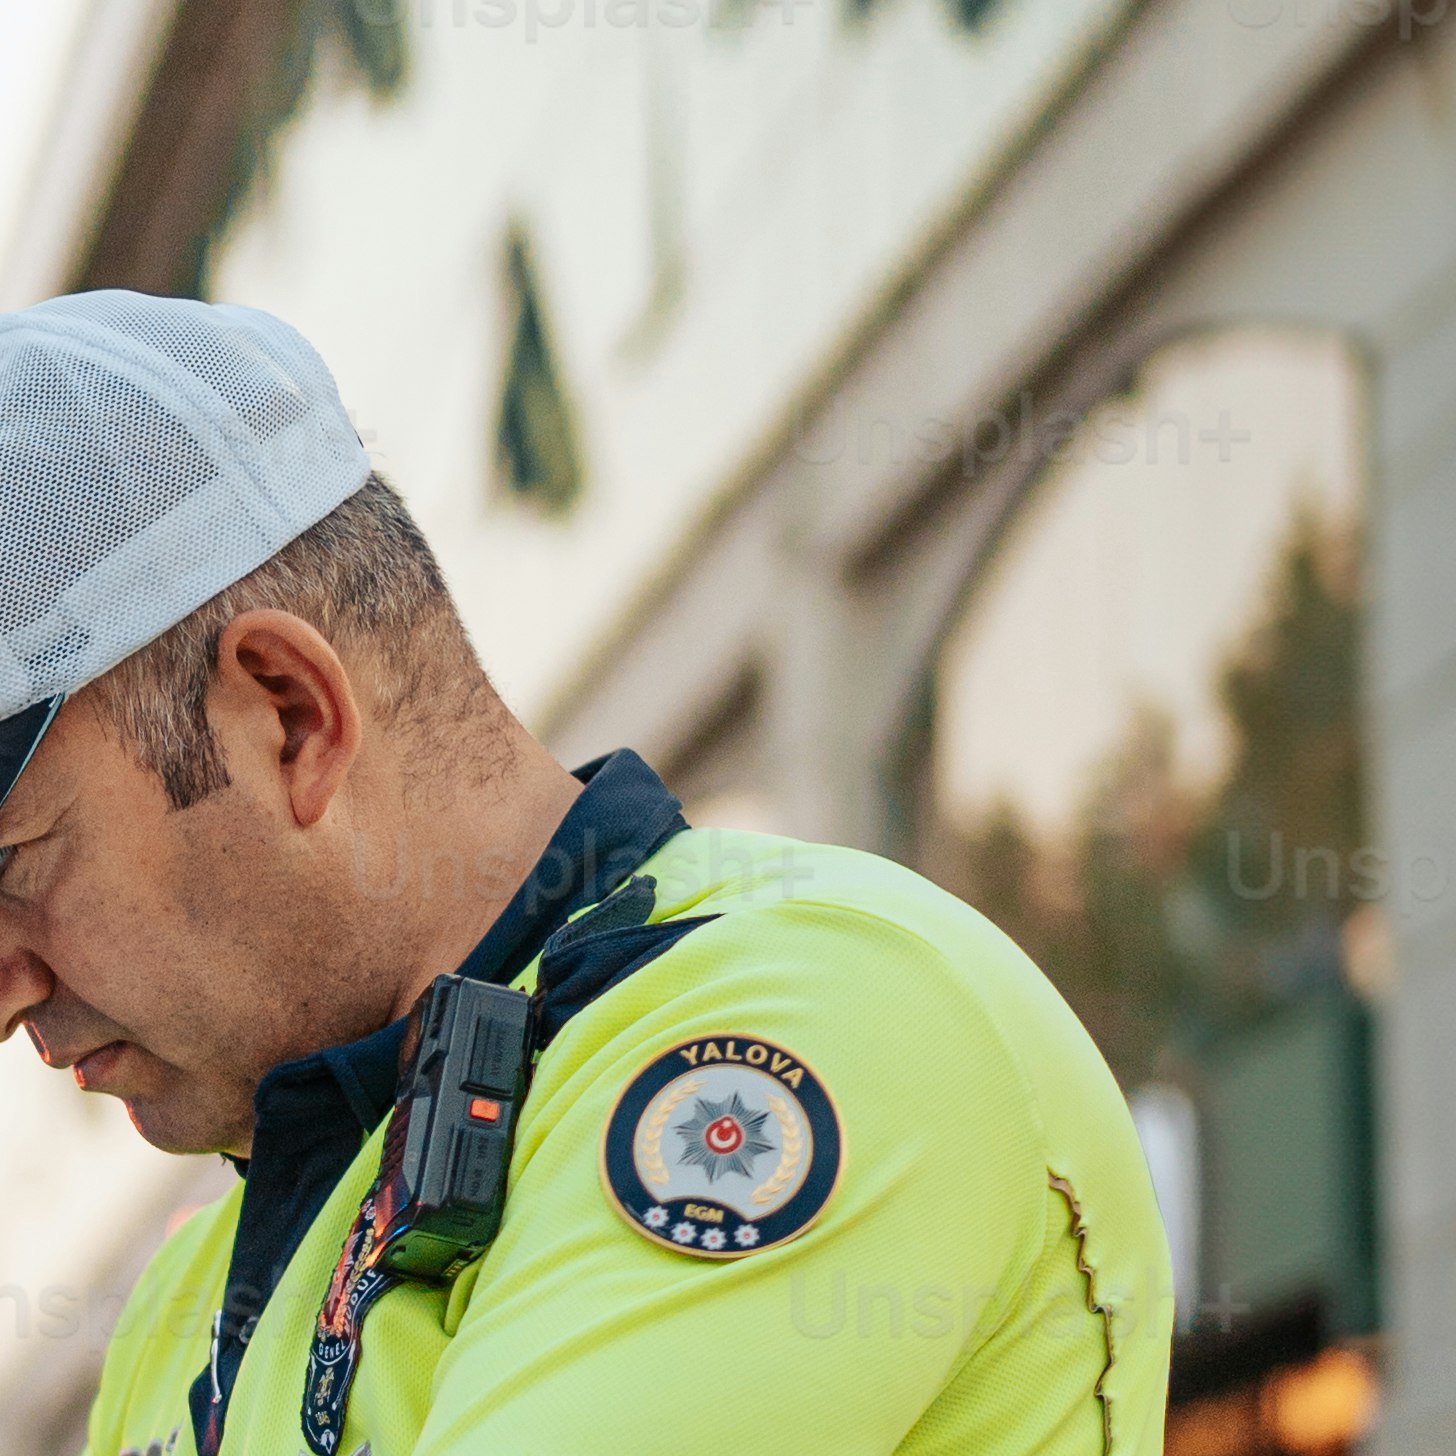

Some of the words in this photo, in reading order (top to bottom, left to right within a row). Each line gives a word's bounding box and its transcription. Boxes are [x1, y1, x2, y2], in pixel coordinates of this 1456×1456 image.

[680, 1041, 806, 1089] YALOVA
[684, 1203, 724, 1223] EGM
[318, 1339, 345, 1359] GENEL
